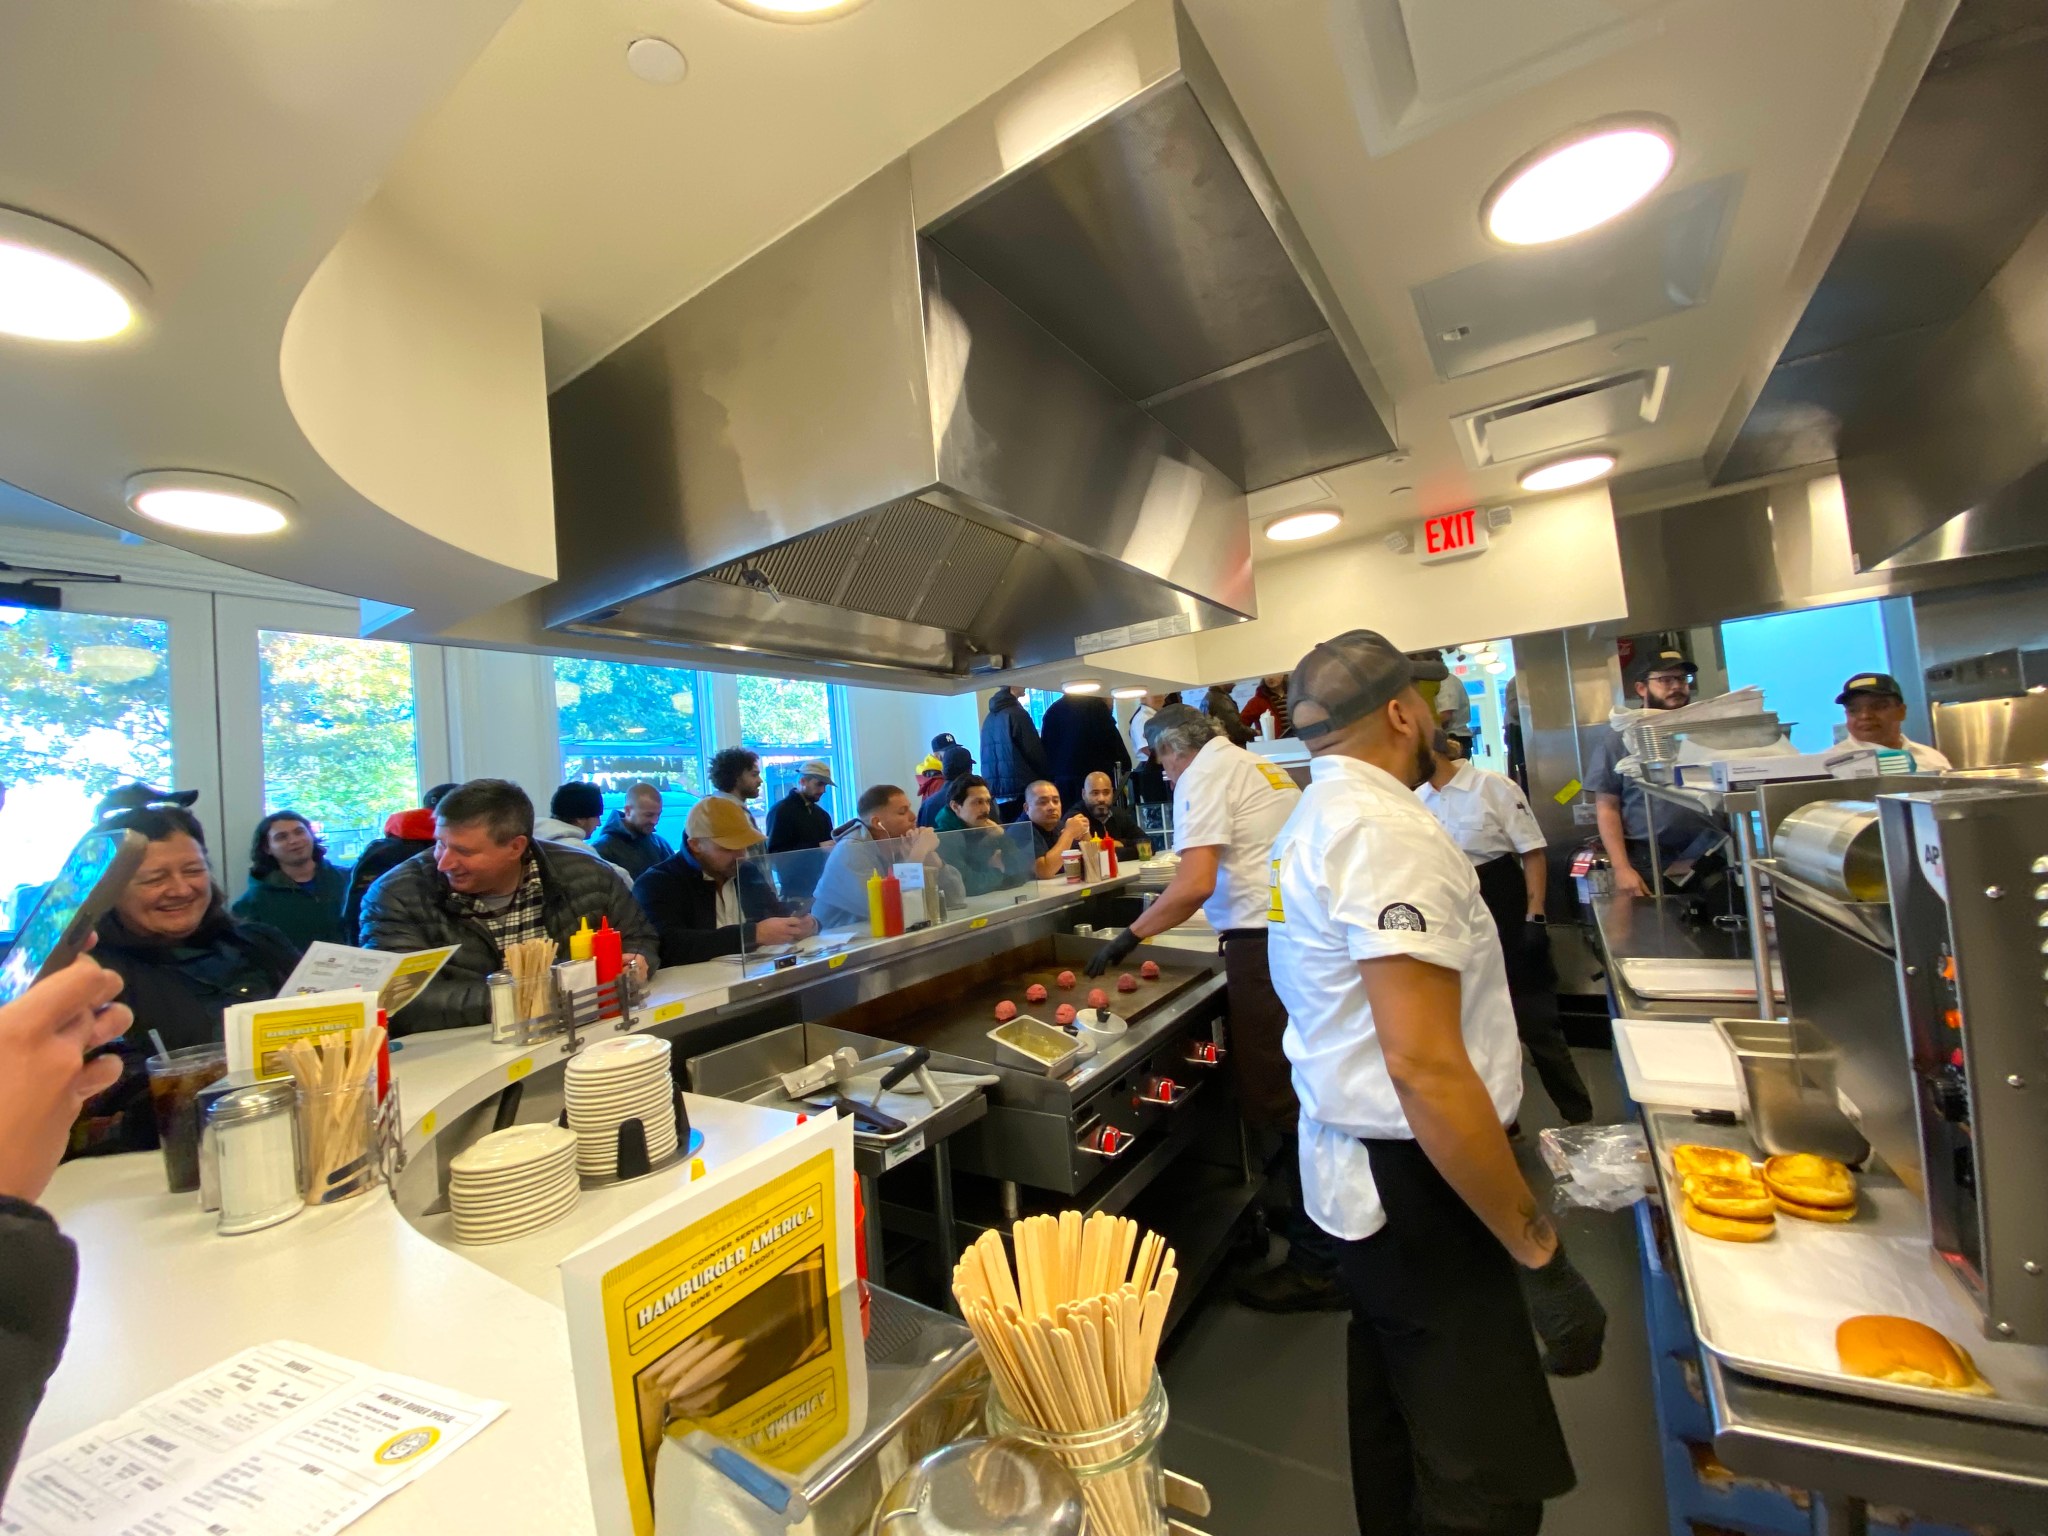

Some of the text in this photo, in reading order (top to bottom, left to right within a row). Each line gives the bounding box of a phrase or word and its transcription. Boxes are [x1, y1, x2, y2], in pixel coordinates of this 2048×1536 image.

[1425, 509, 1476, 554] EXIT
[638, 1205, 815, 1330] HAMBURGER AMERICA
[691, 1218, 770, 1270] COUNTER SERVICE
[690, 1249, 776, 1308] DINE IN TAKEOUT
